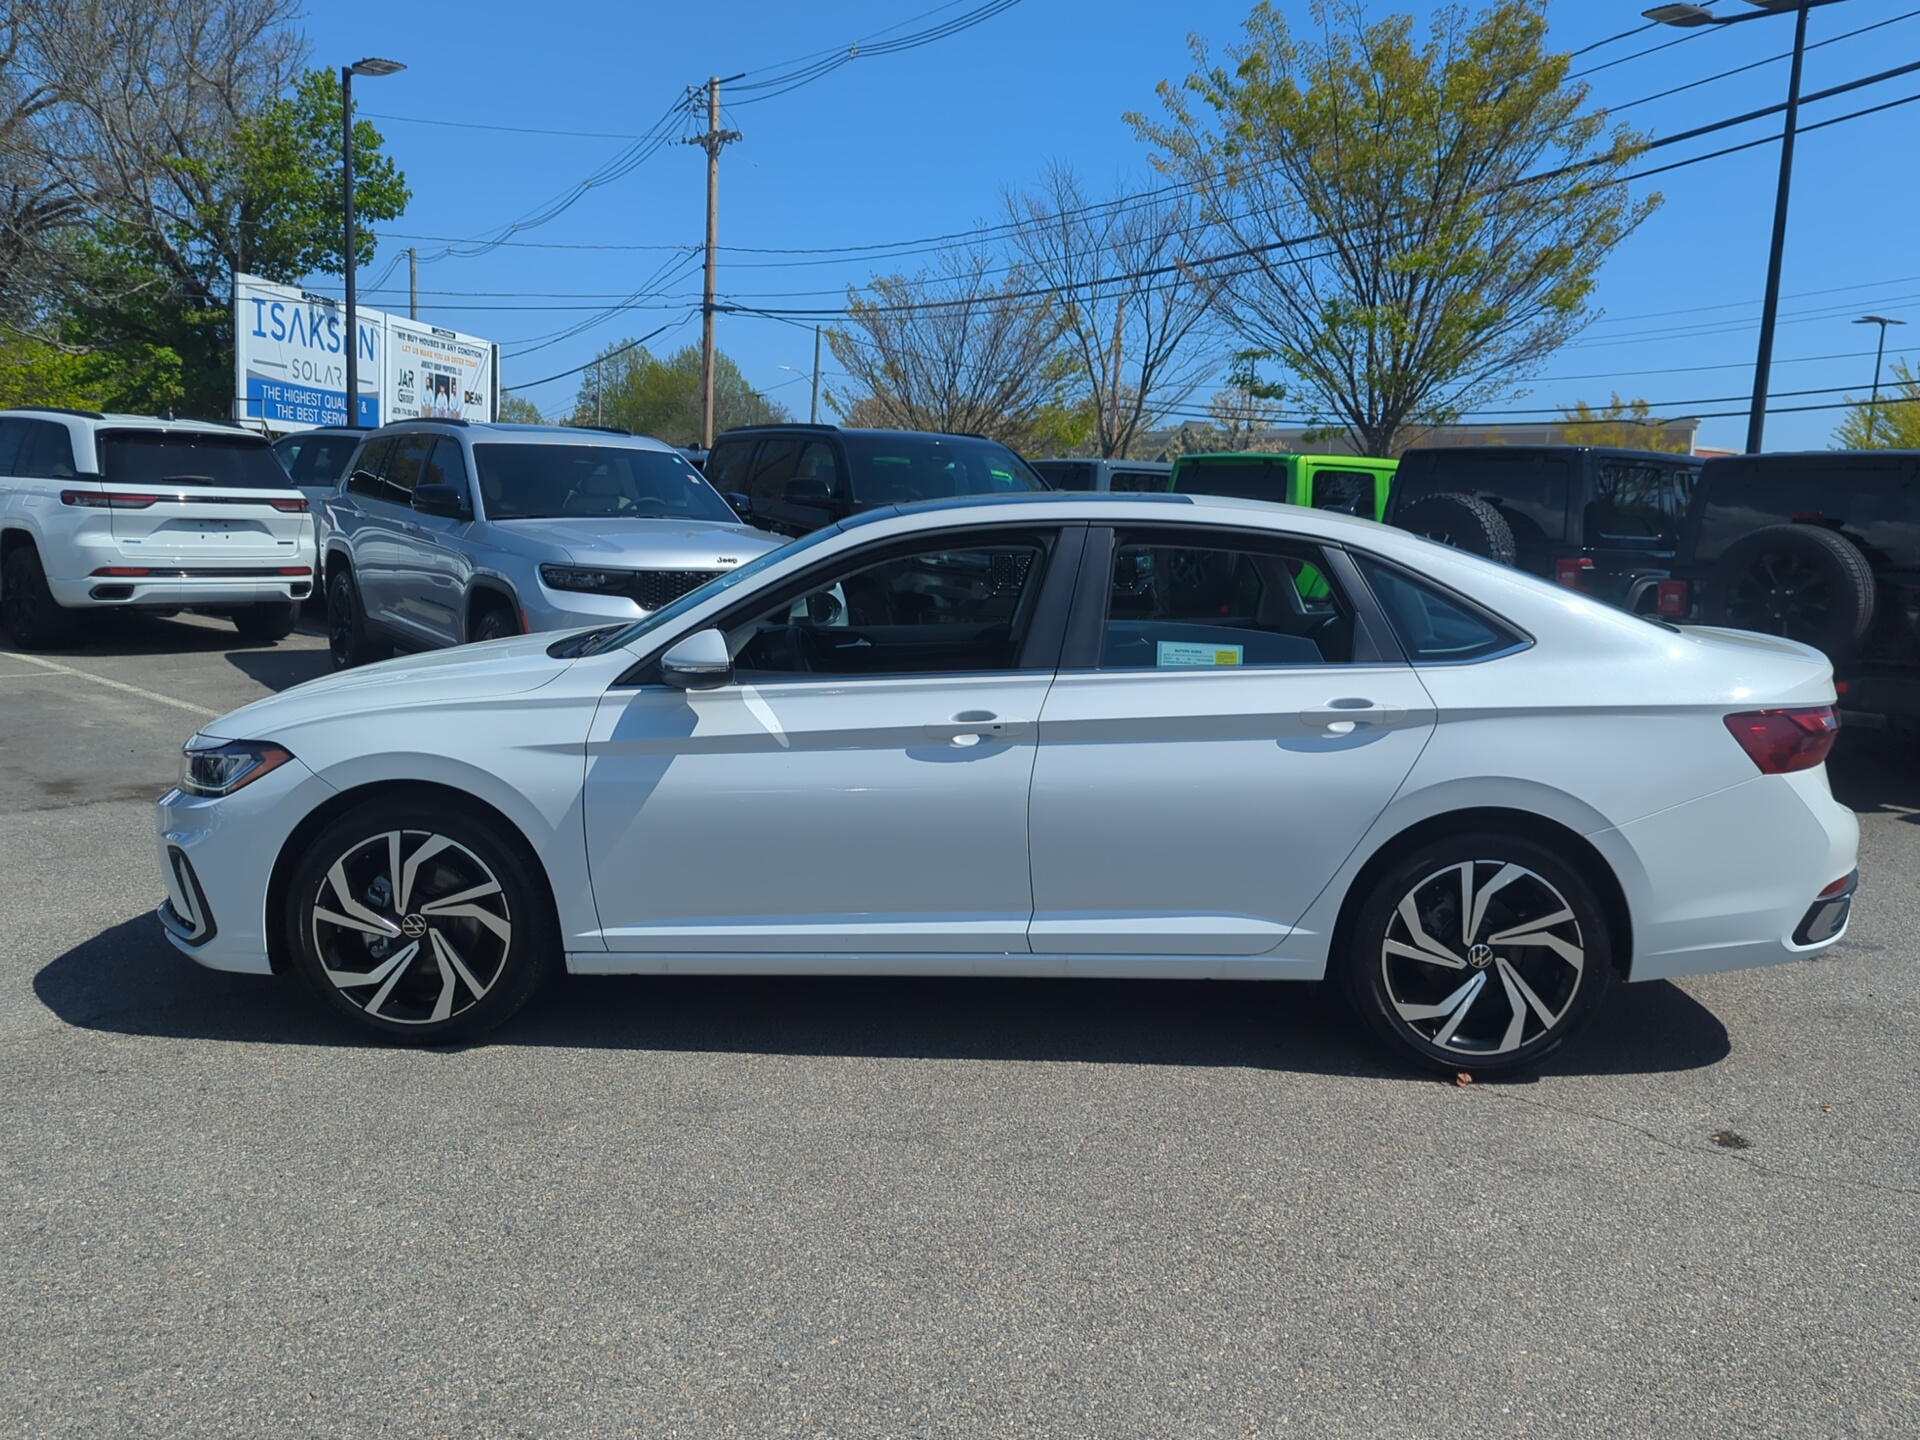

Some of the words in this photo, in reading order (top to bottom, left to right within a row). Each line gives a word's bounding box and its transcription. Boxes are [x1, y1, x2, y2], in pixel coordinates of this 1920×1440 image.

[251, 297, 374, 362] ISAKSN
[397, 332, 406, 341] WE
[407, 334, 418, 343] BUY
[419, 336, 439, 349] HOUSES
[440, 342, 446, 350] IN
[447, 344, 456, 353] ANY
[457, 345, 482, 359] CONDITION
[291, 358, 342, 387] SOLAR
[398, 368, 414, 389] JAR
[262, 385, 281, 401] THE
[284, 388, 322, 407] HIGHEST
[361, 401, 367, 413] &
[464, 390, 483, 406] DEAN
[276, 403, 294, 419] THE
[296, 406, 319, 422] BEST
[717, 556, 738, 564] Jeep
